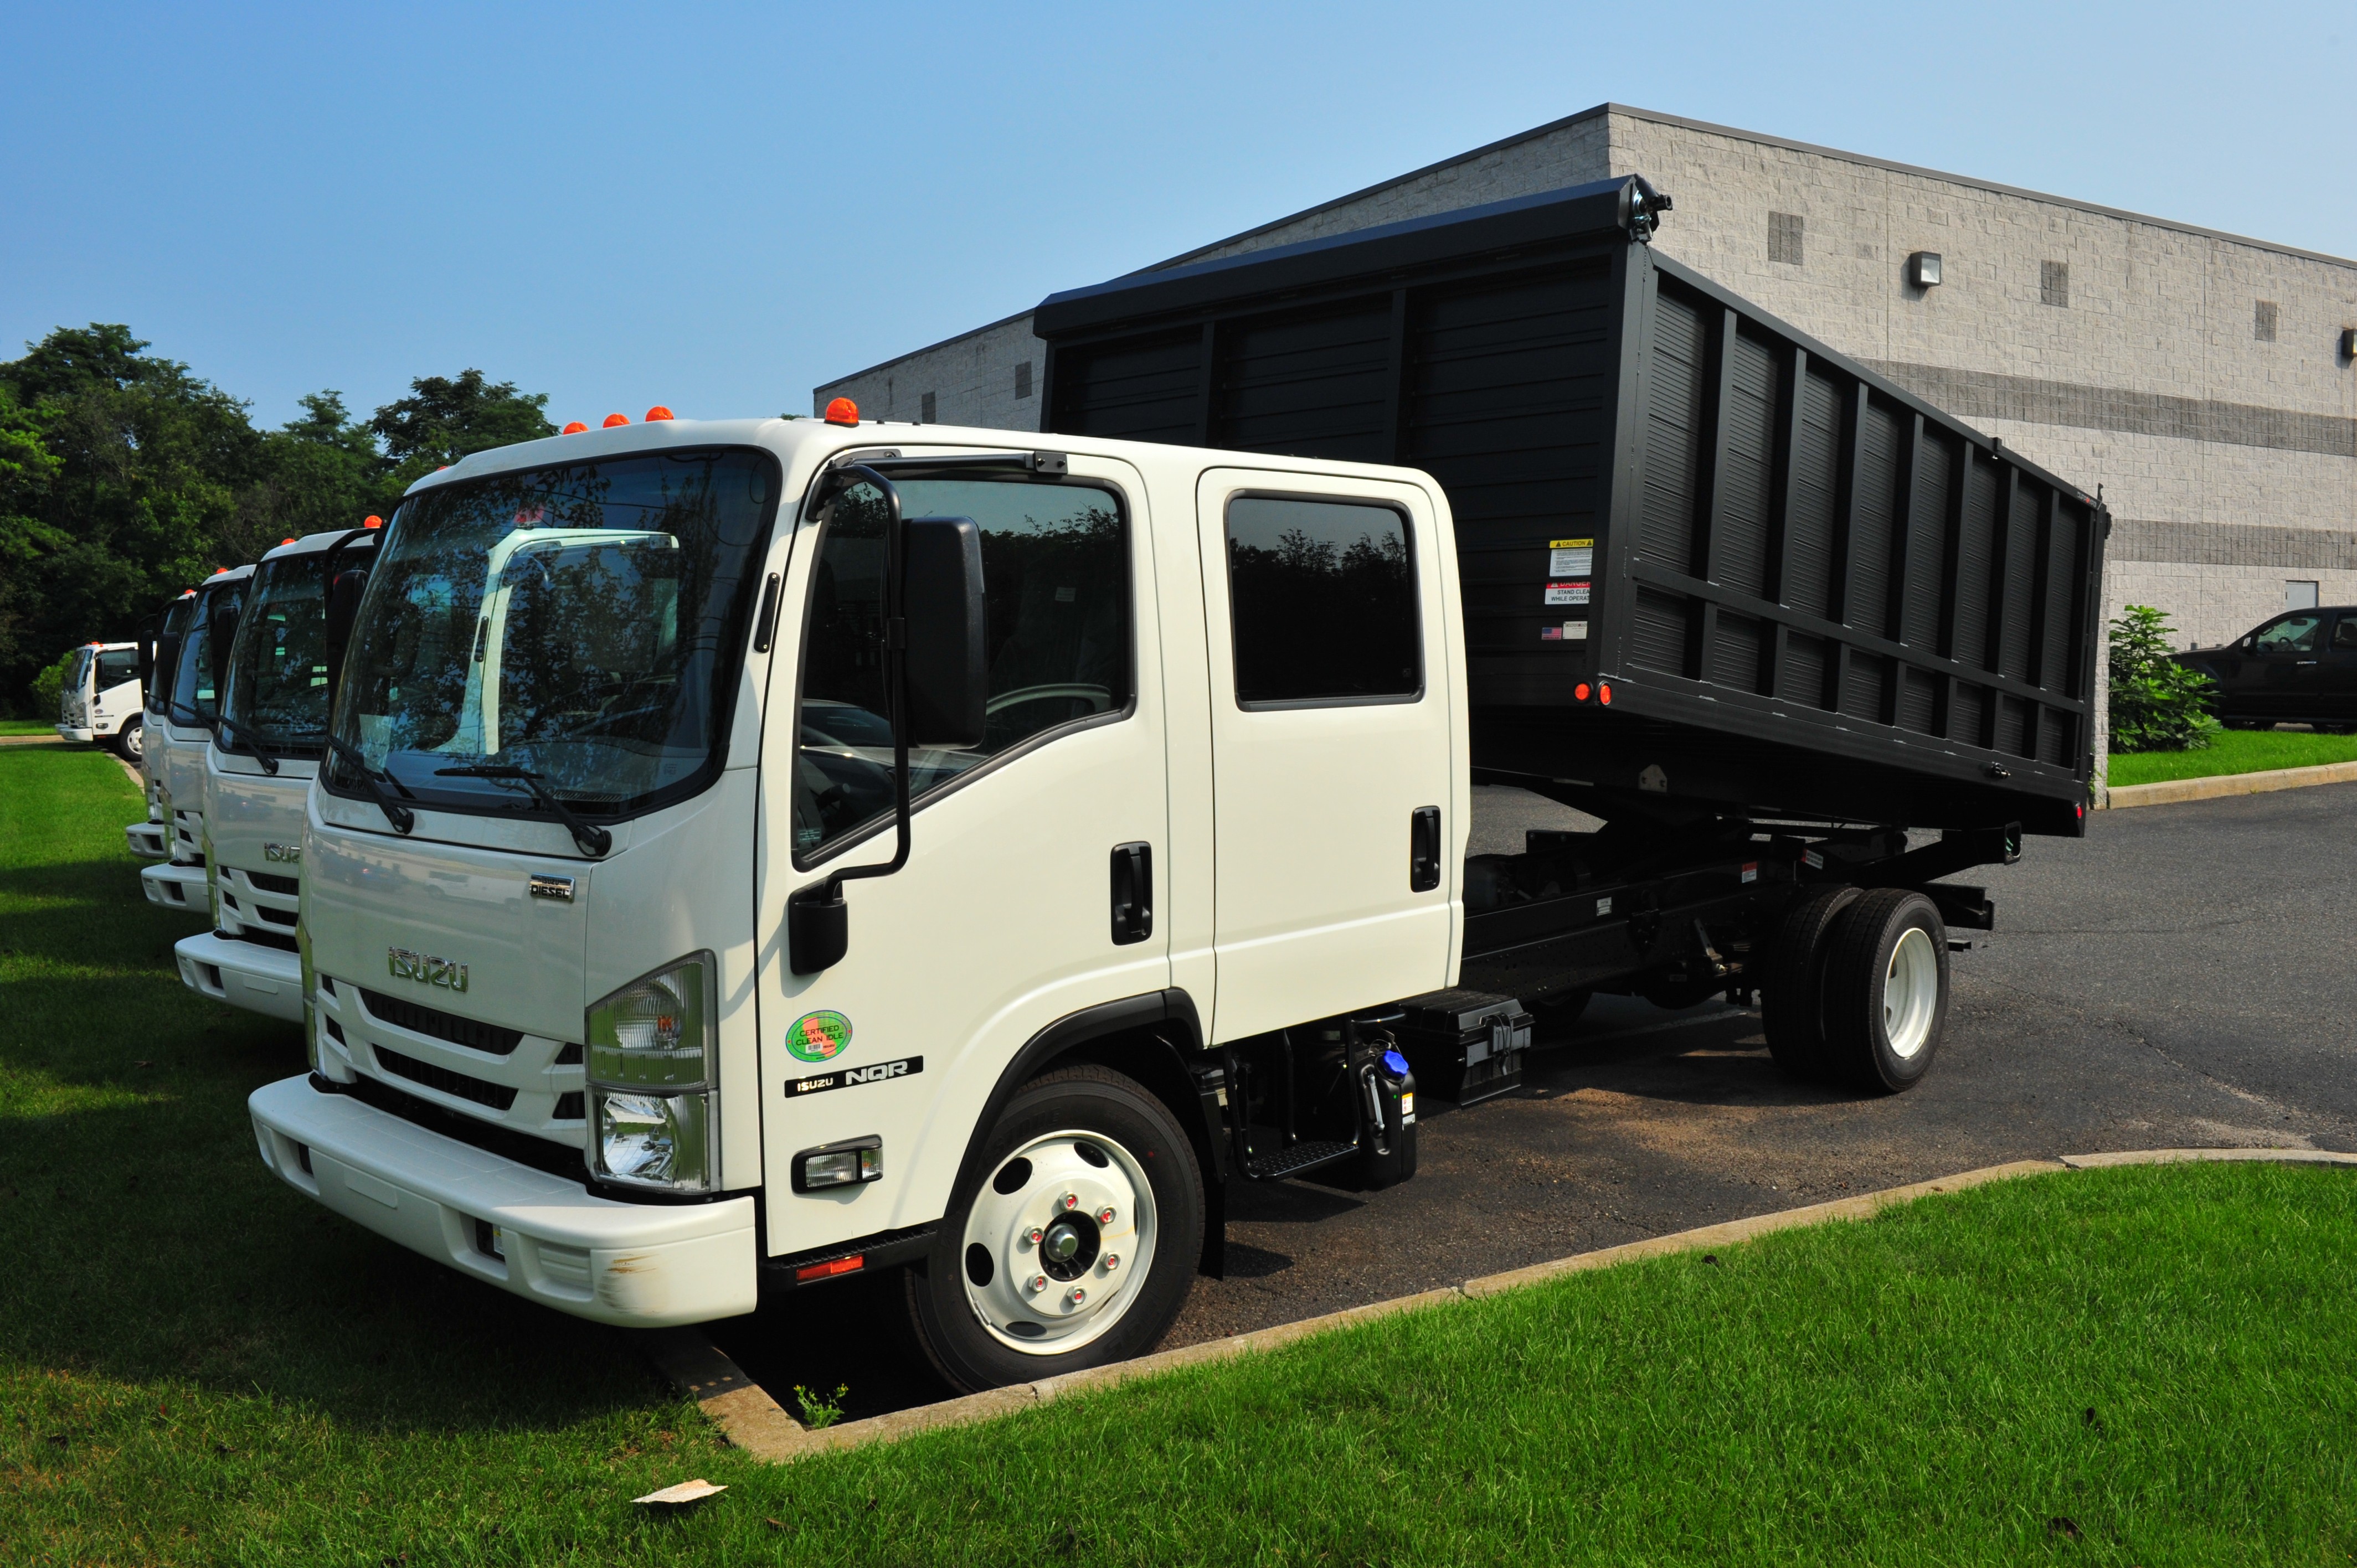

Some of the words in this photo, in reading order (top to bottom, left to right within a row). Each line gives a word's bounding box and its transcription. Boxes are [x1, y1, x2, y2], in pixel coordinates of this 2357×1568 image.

[531, 885, 569, 899] DIESEL
[389, 946, 469, 993] ISUZU
[799, 1025, 840, 1037] CERTIFIED
[796, 1036, 822, 1046] CLEAN
[826, 1032, 843, 1041] IDLE
[797, 1077, 833, 1092] ISUZU
[845, 1061, 908, 1085] NQR
